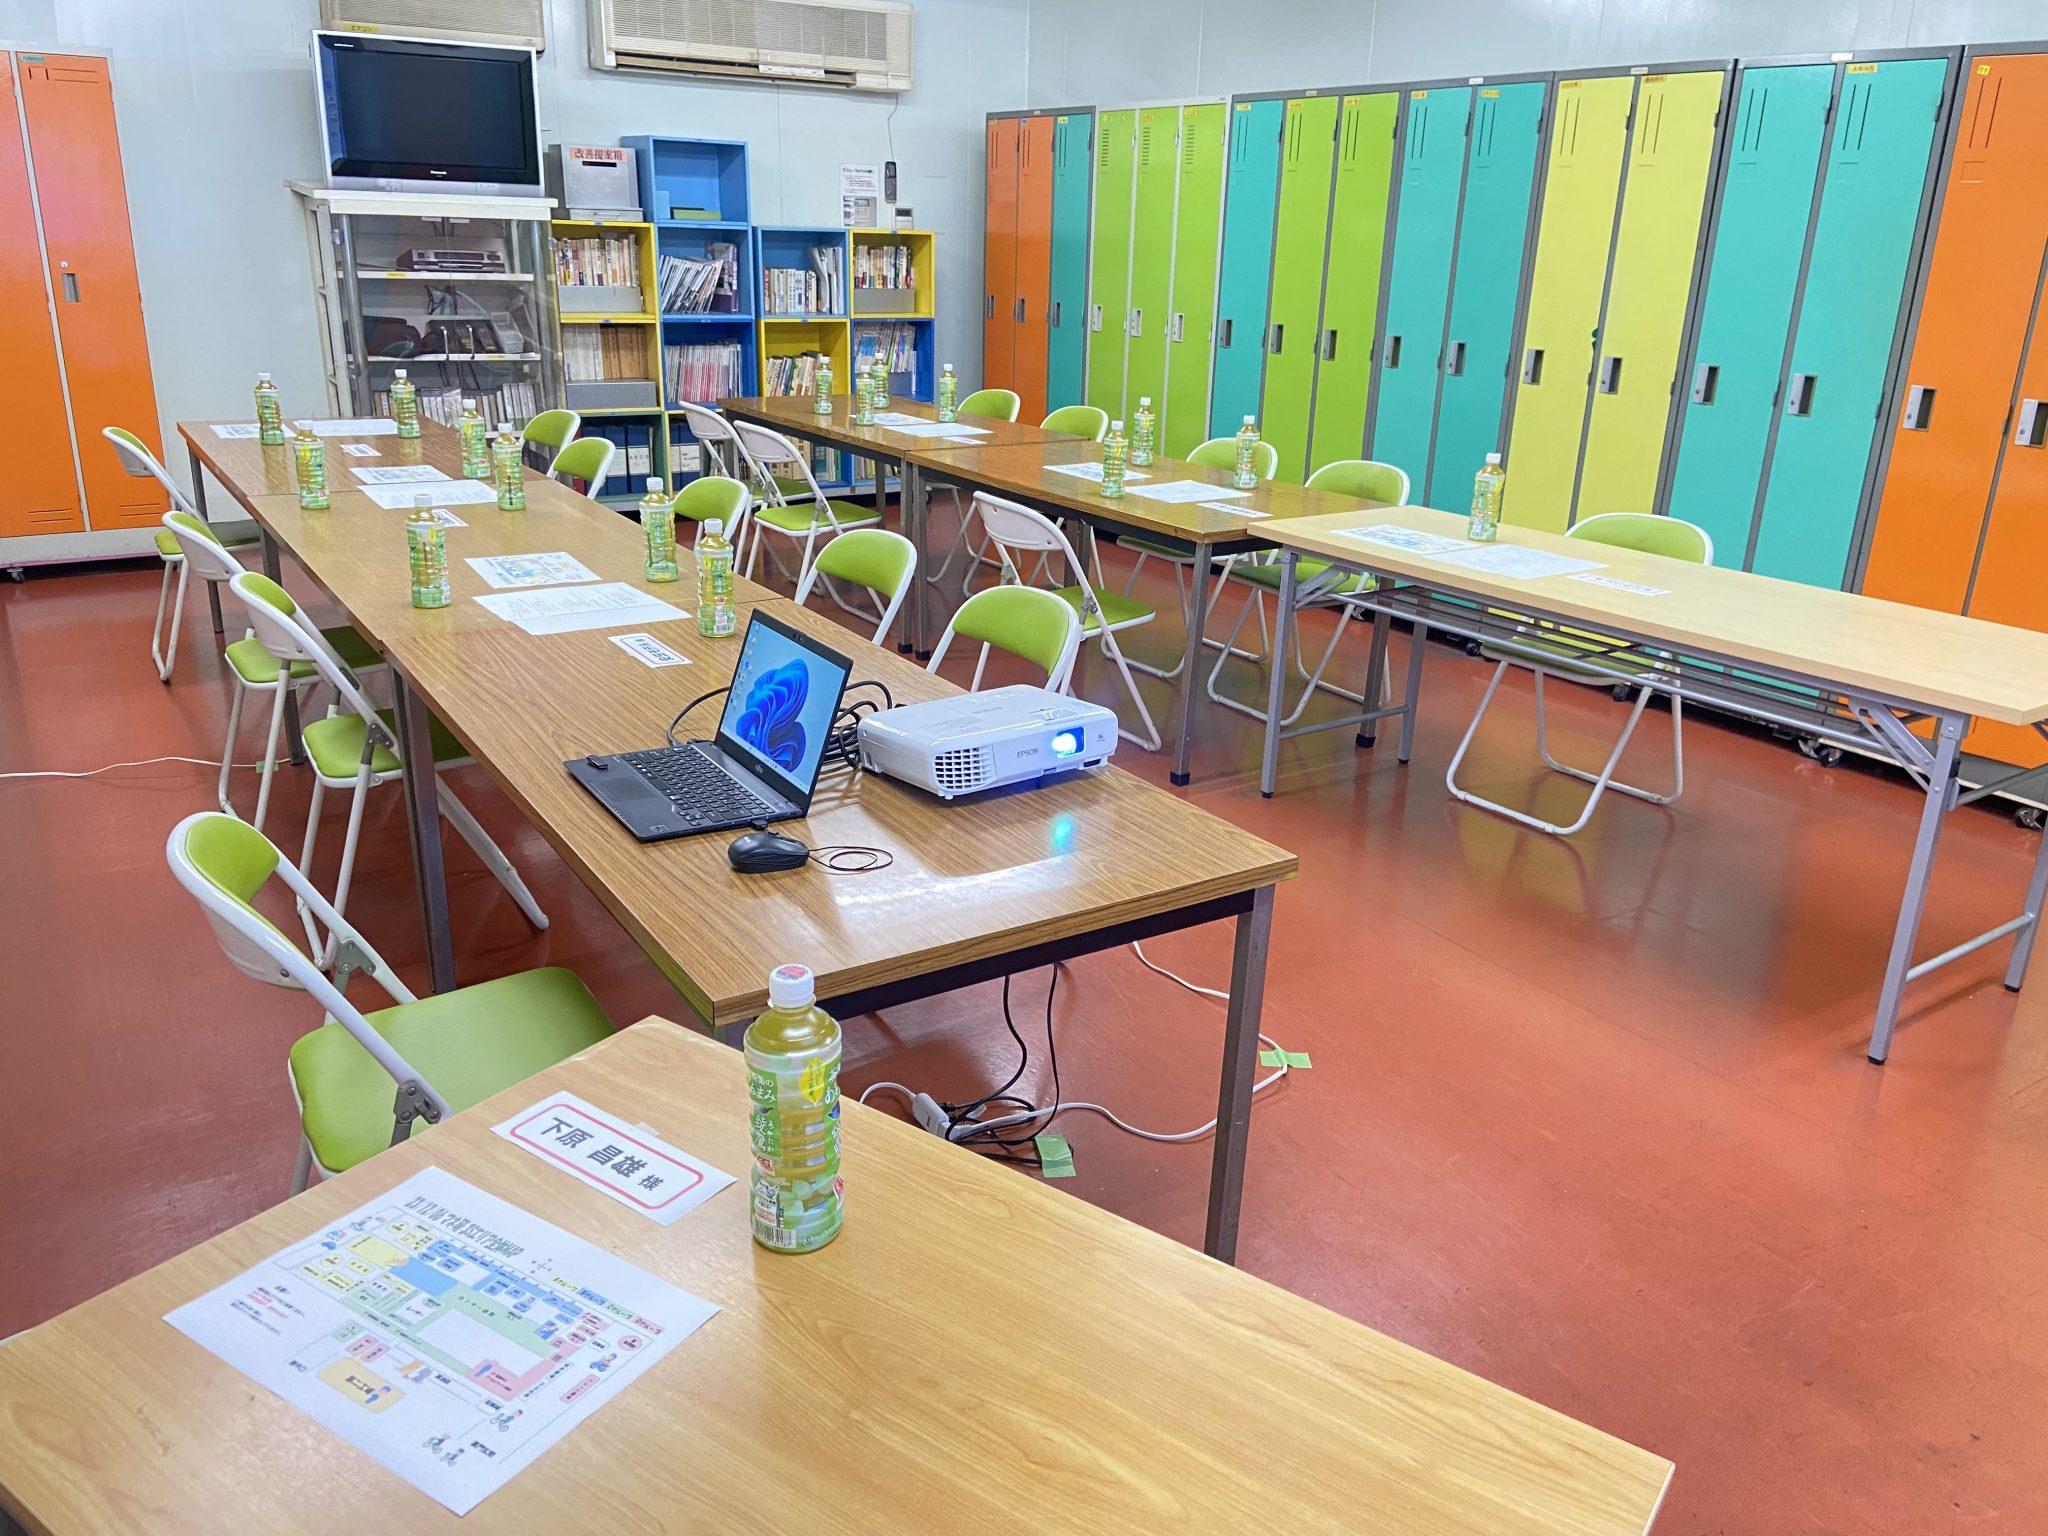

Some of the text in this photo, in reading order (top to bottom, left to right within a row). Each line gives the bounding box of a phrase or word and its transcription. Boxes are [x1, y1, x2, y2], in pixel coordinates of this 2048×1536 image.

[575, 148, 622, 161] 改善提案箱
[1017, 748, 1039, 758] EPSON
[540, 1117, 664, 1191] 下原 昌雄 様
